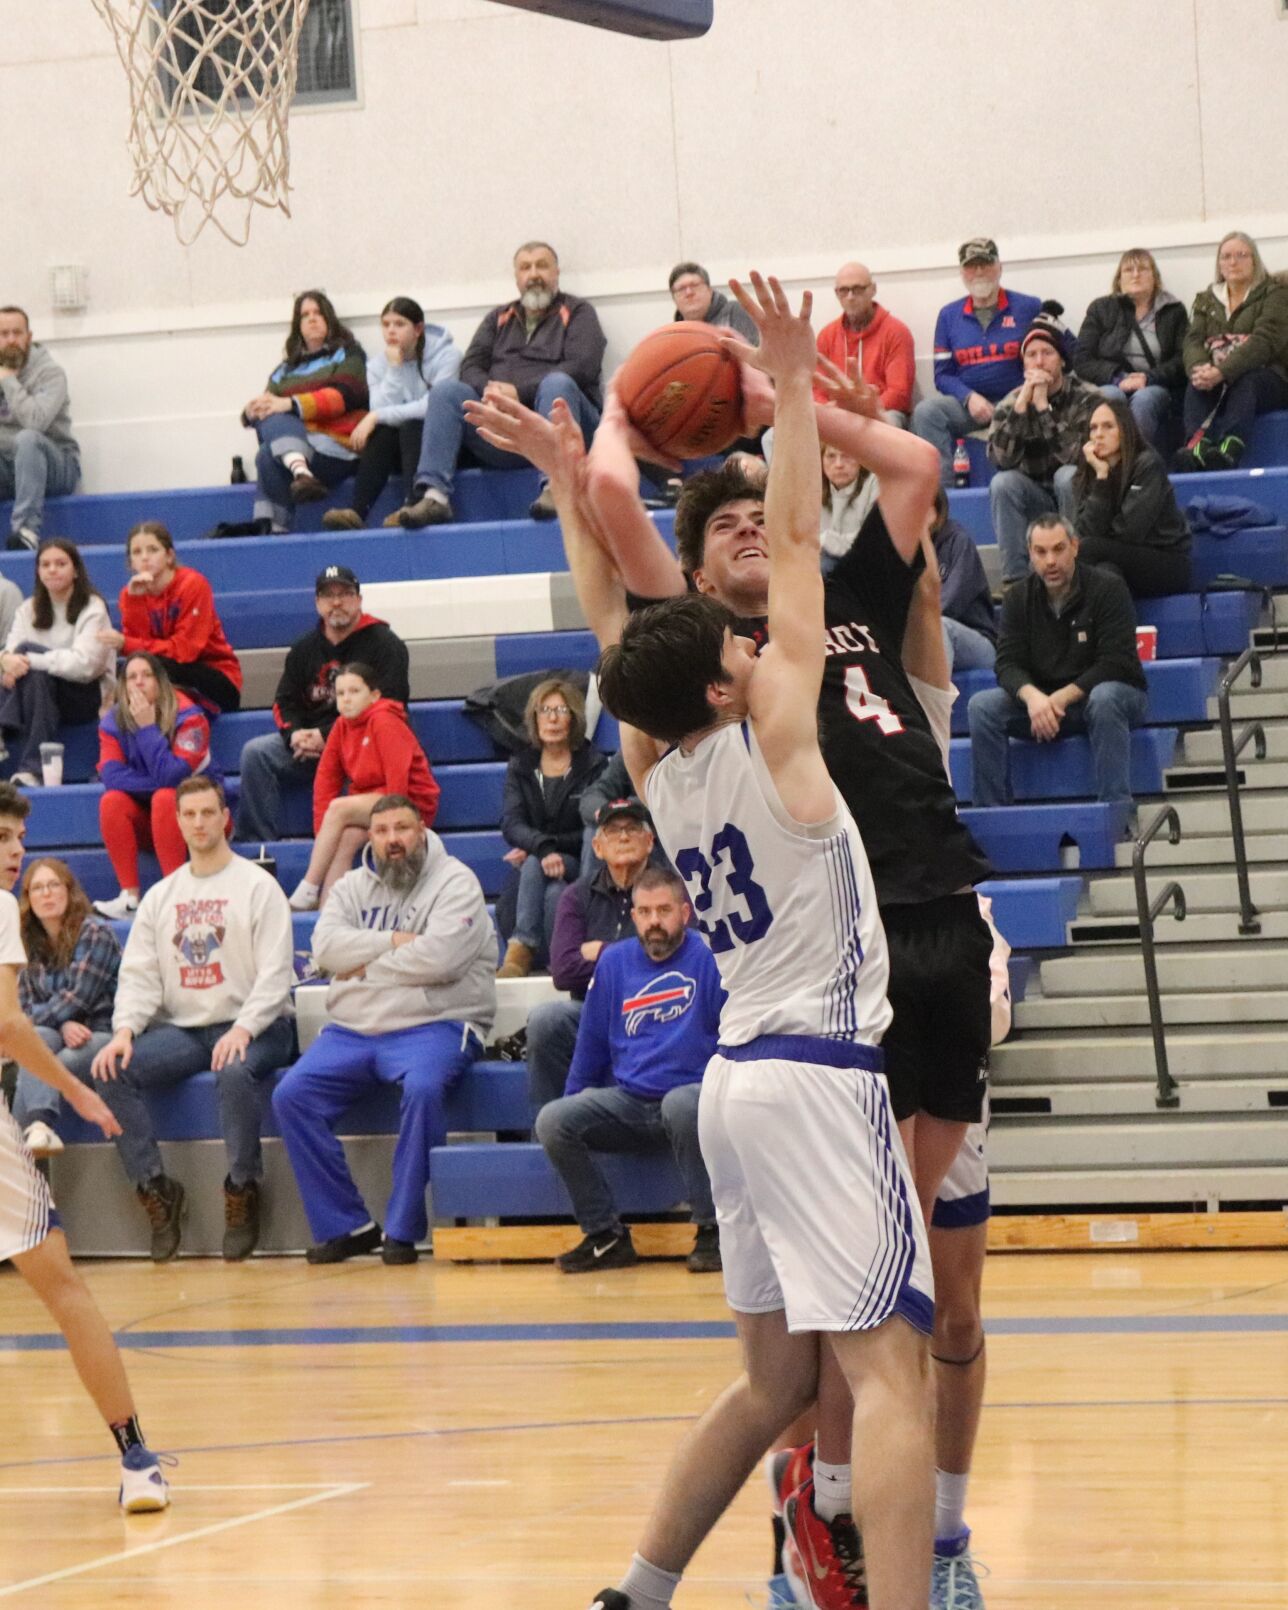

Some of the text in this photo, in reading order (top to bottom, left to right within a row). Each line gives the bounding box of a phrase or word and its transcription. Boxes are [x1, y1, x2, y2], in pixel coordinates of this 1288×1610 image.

[955, 342, 1019, 366] BILLS
[844, 664, 904, 736] 4
[675, 822, 774, 954] 23
